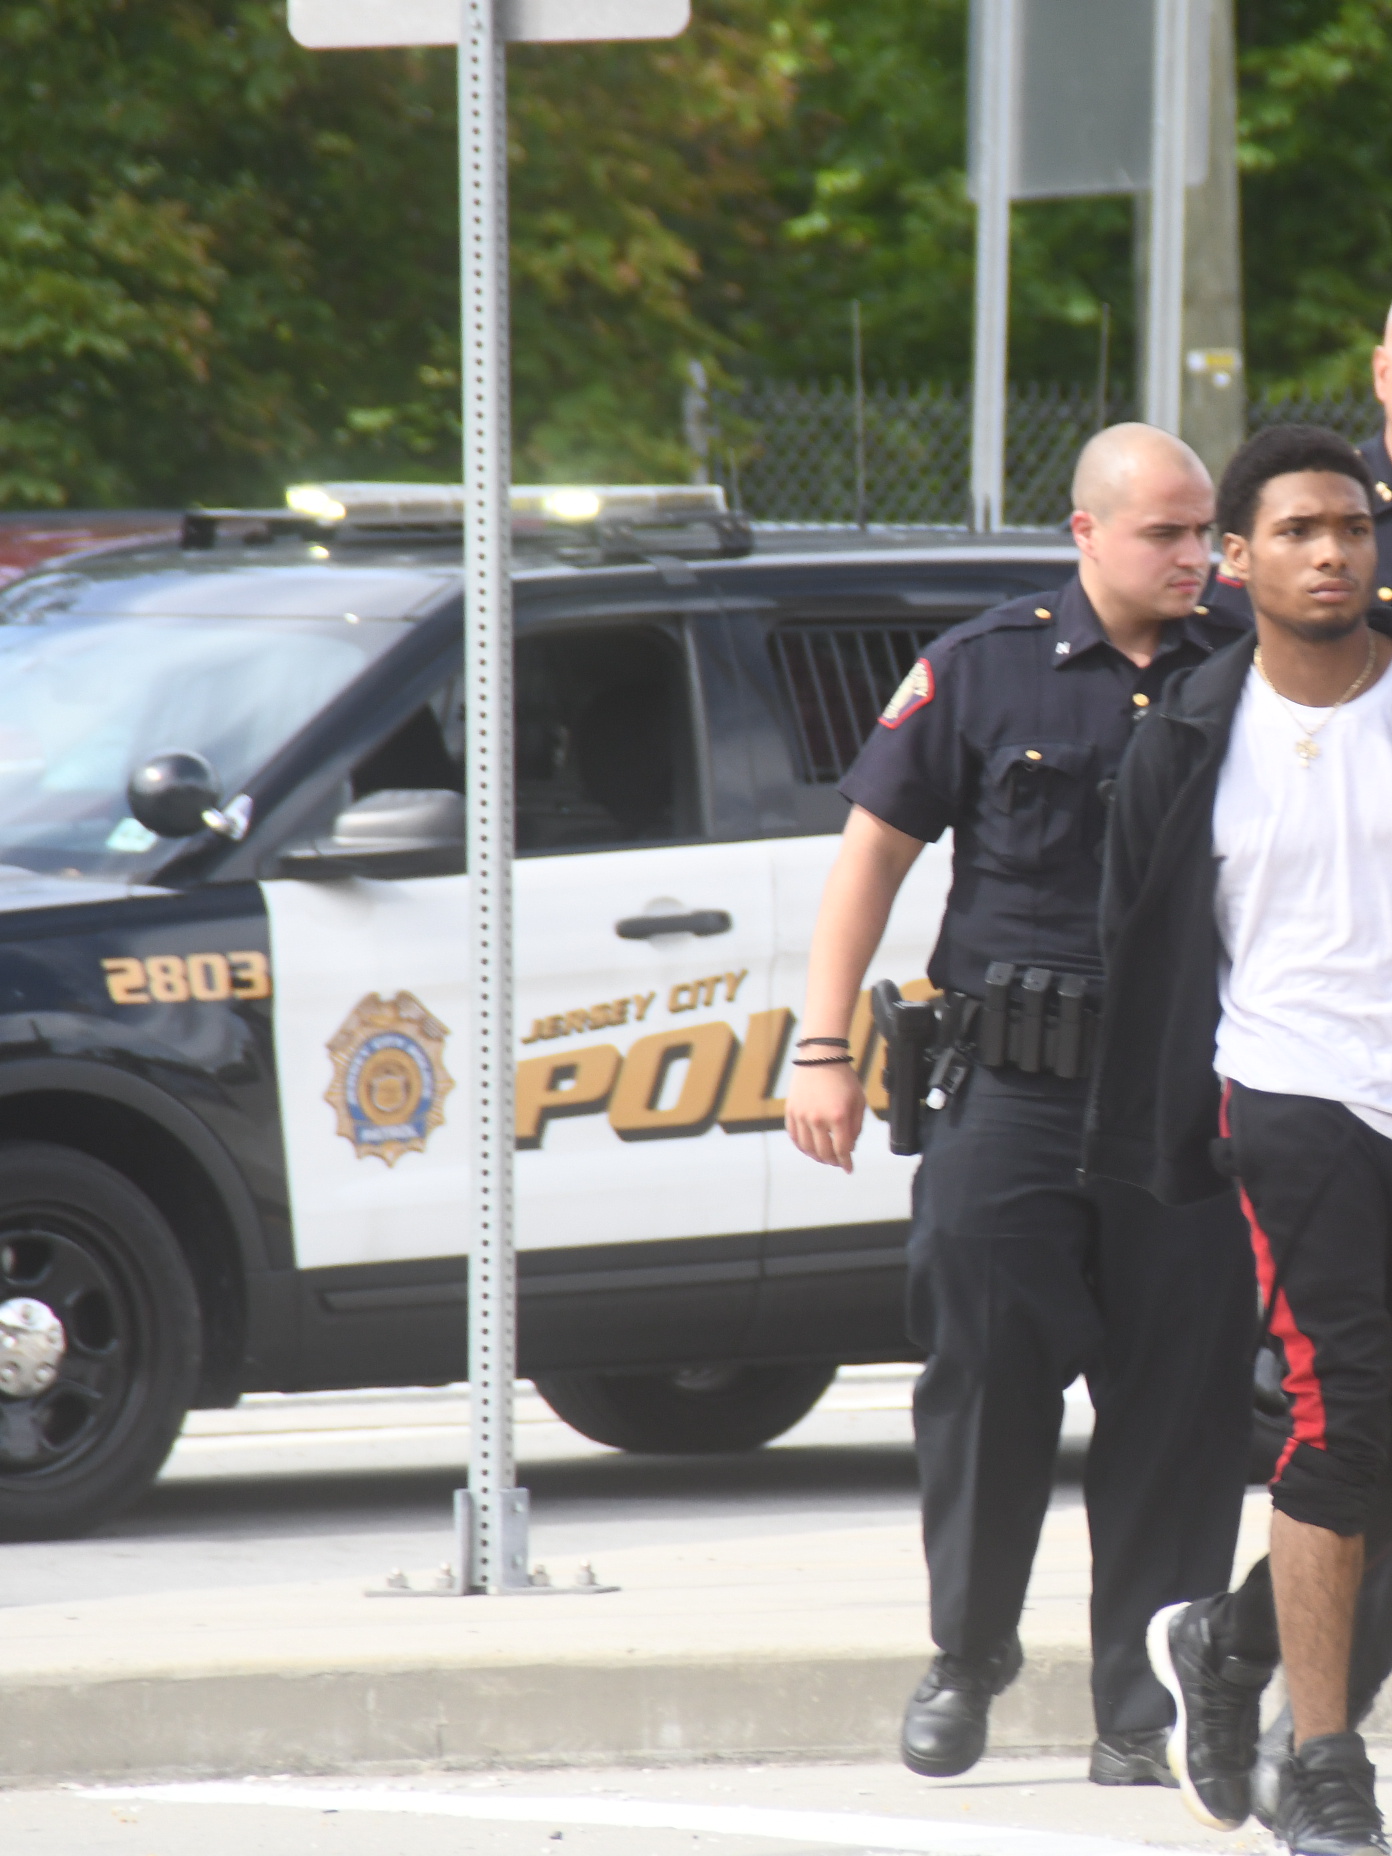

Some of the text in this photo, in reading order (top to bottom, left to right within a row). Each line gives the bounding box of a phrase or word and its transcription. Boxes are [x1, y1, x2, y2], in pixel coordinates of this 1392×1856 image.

[101, 951, 272, 1005] 2803
[521, 969, 748, 1045] JERSEY CITY
